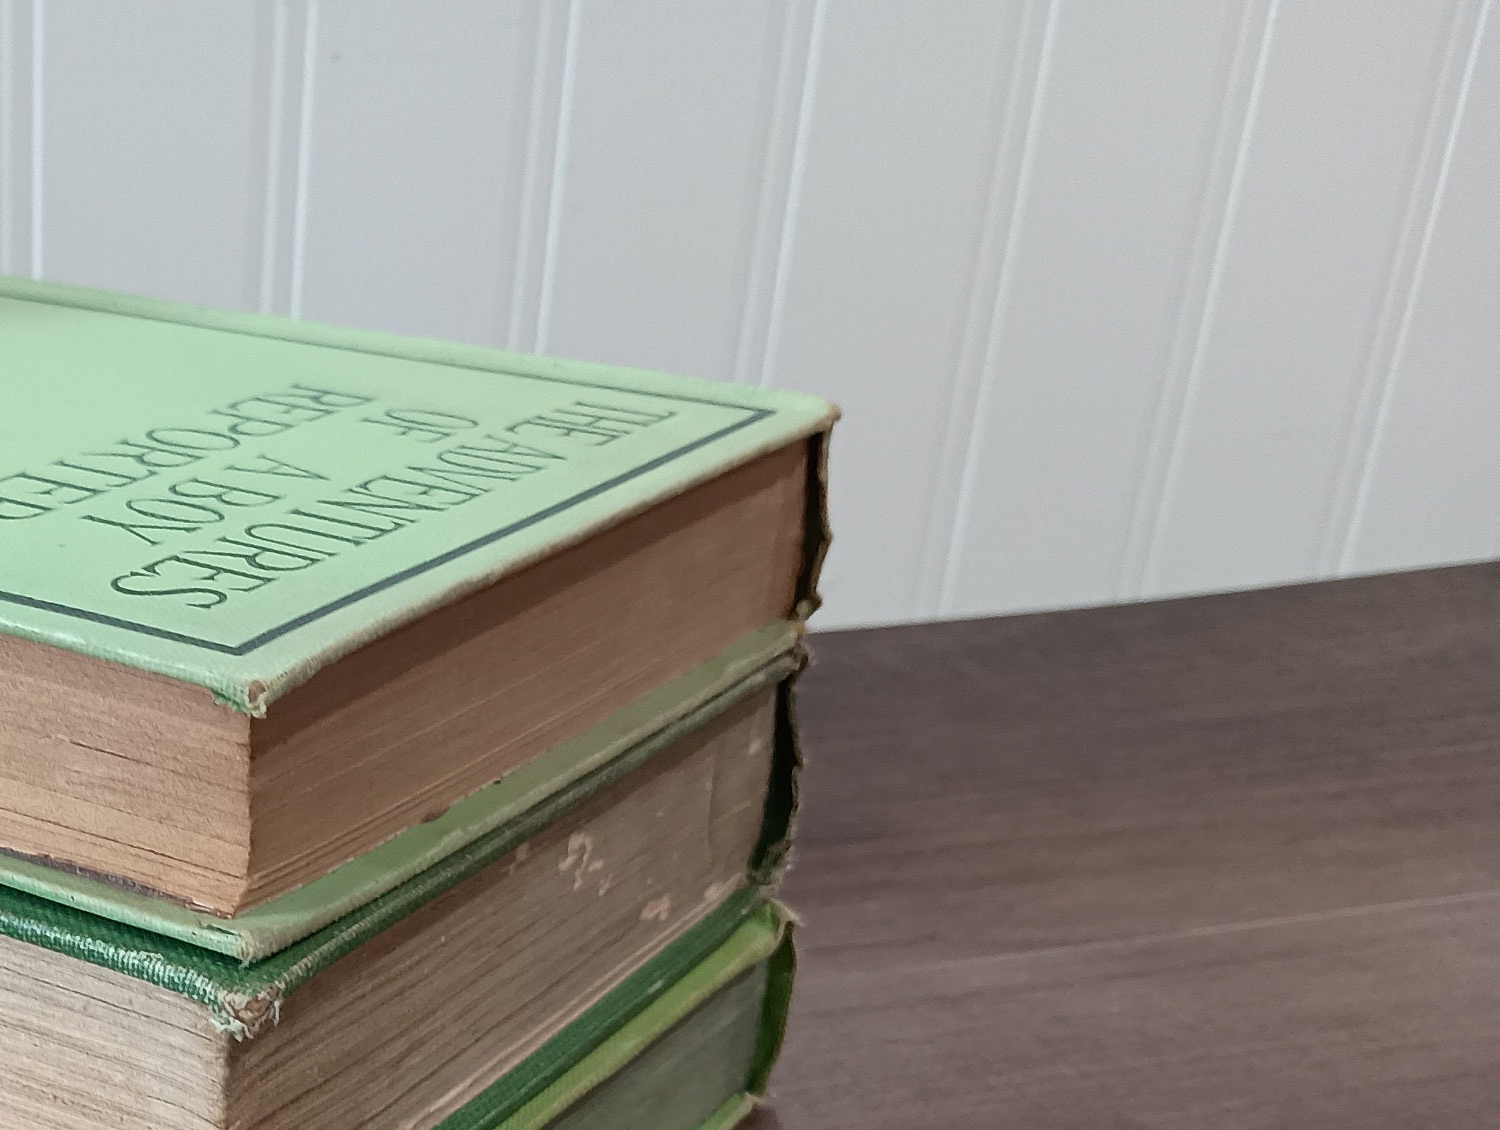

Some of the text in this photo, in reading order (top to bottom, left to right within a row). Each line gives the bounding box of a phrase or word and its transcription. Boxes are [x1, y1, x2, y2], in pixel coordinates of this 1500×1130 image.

[78, 408, 480, 547] OF A BOY
[109, 400, 678, 610] THE ADVENTURES
